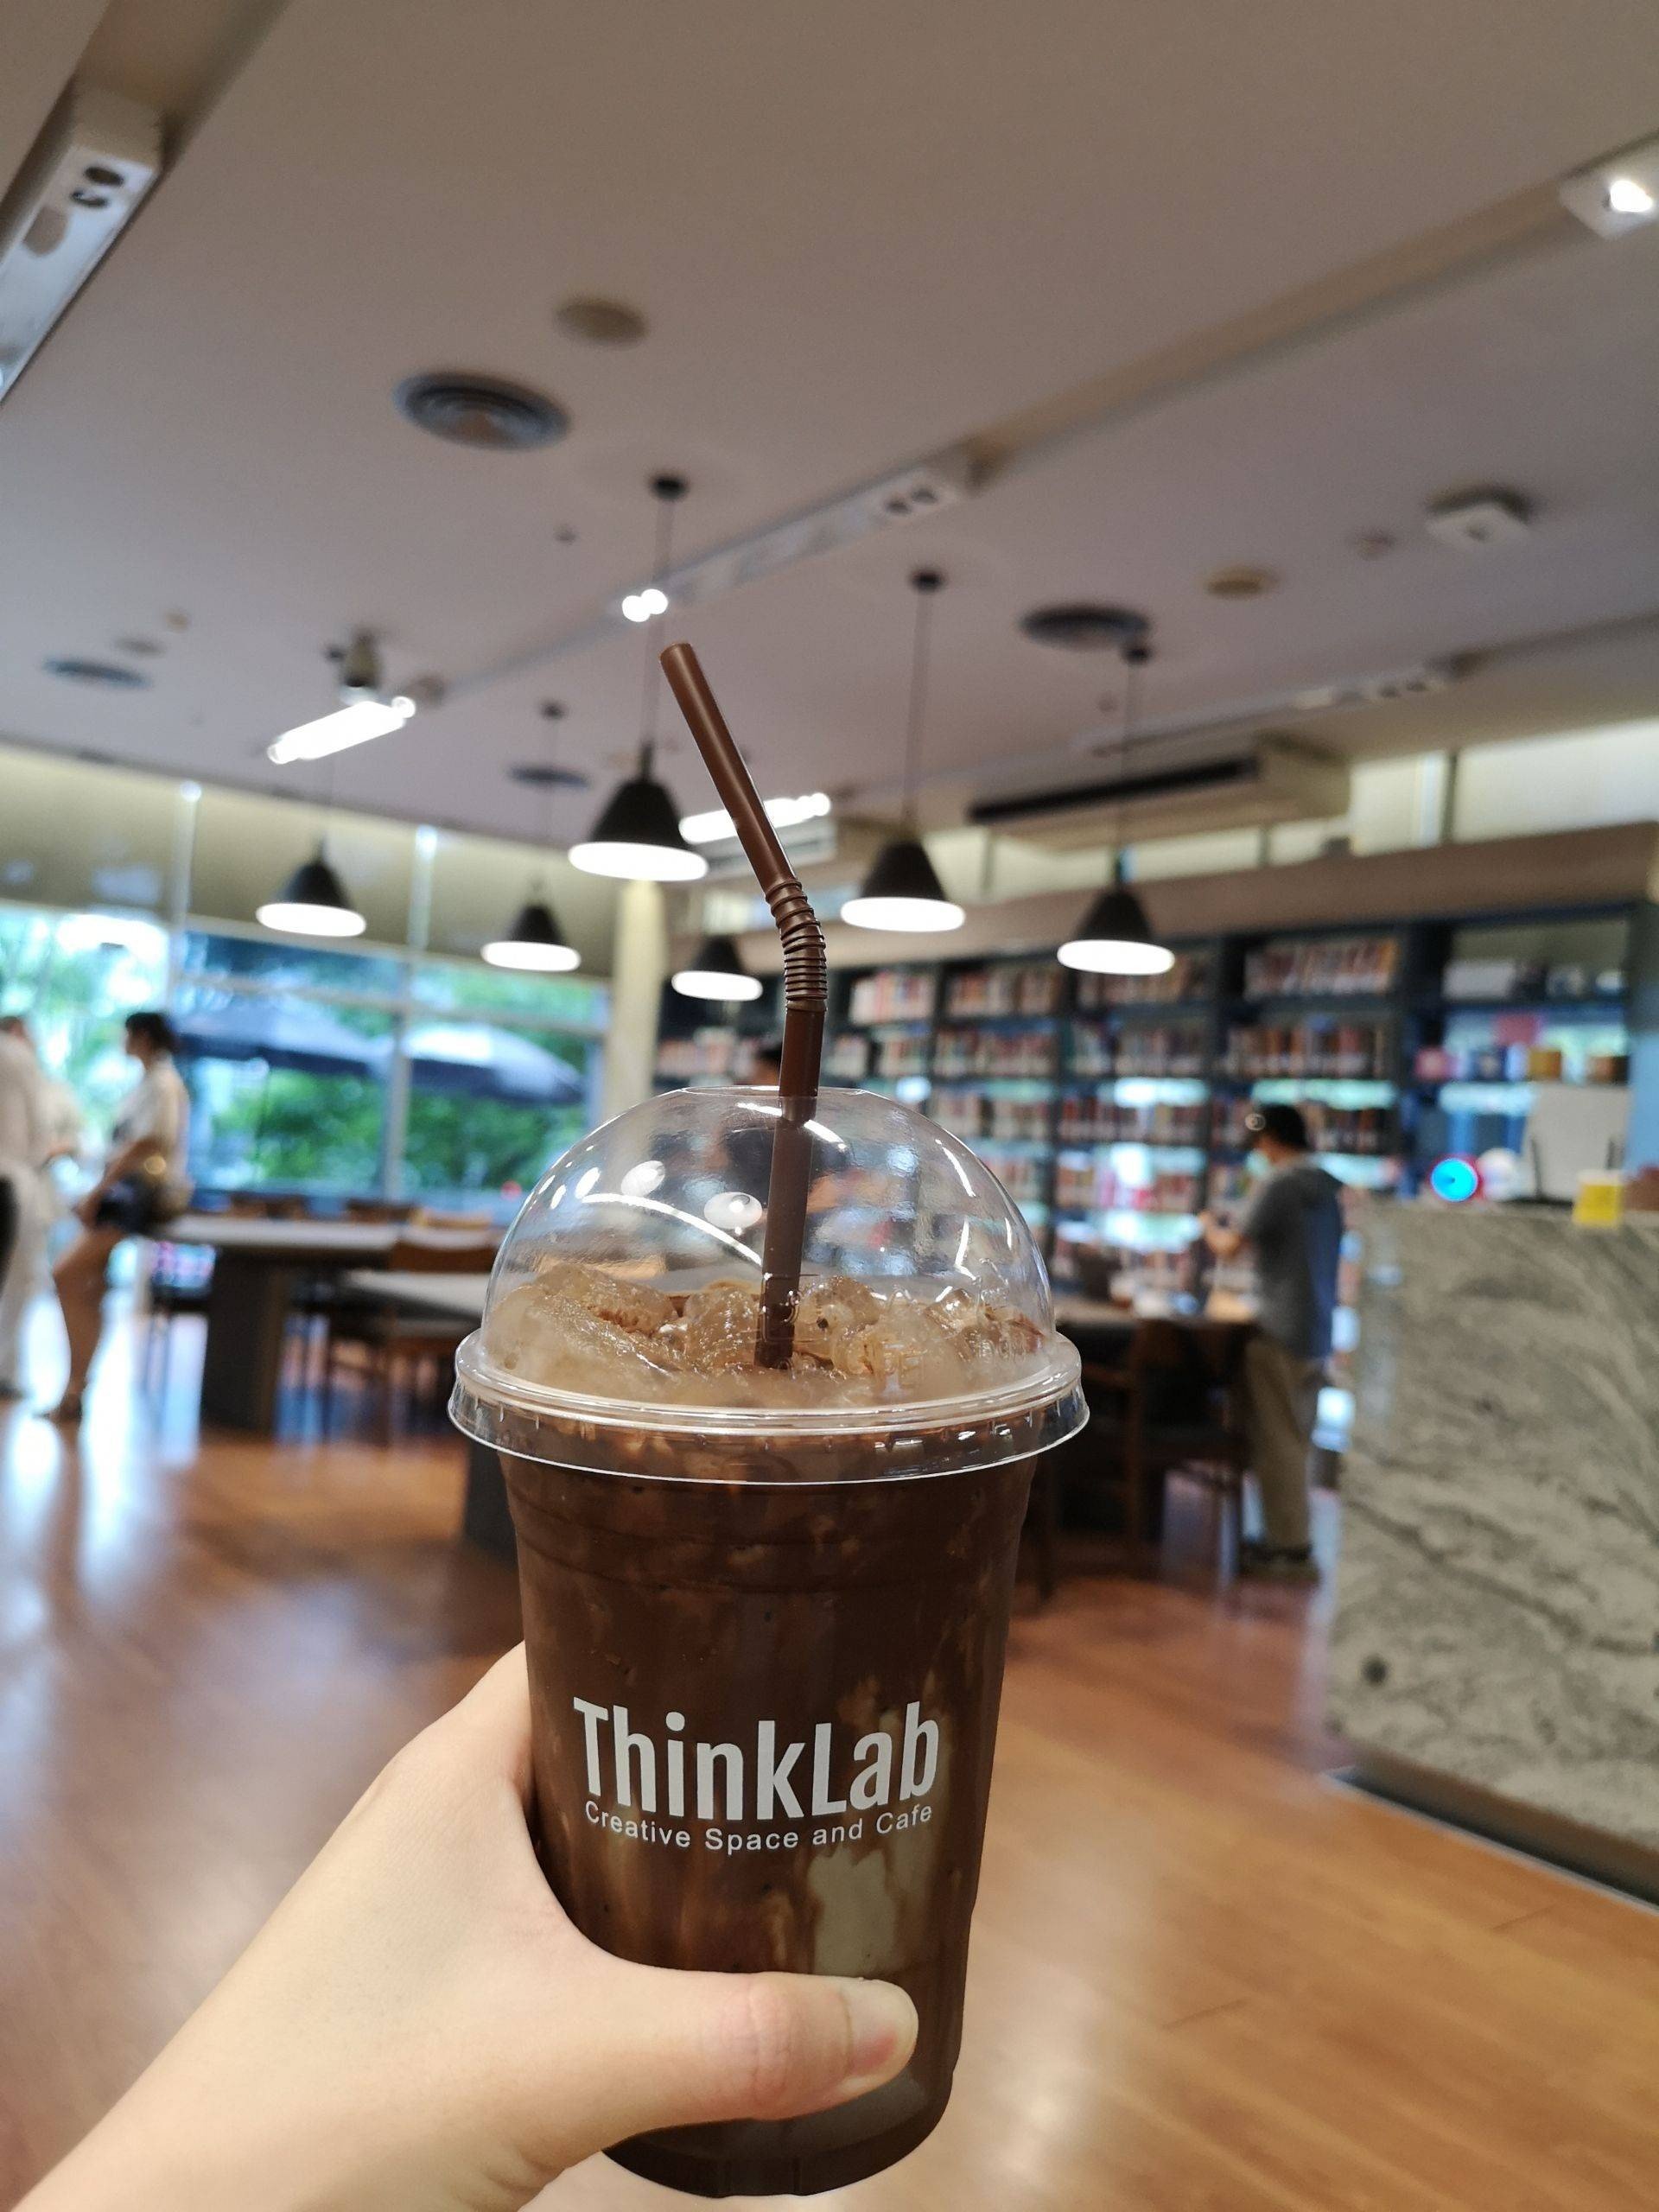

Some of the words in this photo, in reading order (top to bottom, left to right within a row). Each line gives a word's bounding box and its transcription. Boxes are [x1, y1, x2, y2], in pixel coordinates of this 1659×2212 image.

[574, 1697, 939, 1821] ThinkLab
[585, 1801, 691, 1848] Creative
[704, 1828, 798, 1855] Space
[812, 1819, 863, 1846] and
[876, 1804, 932, 1835] Cafe
